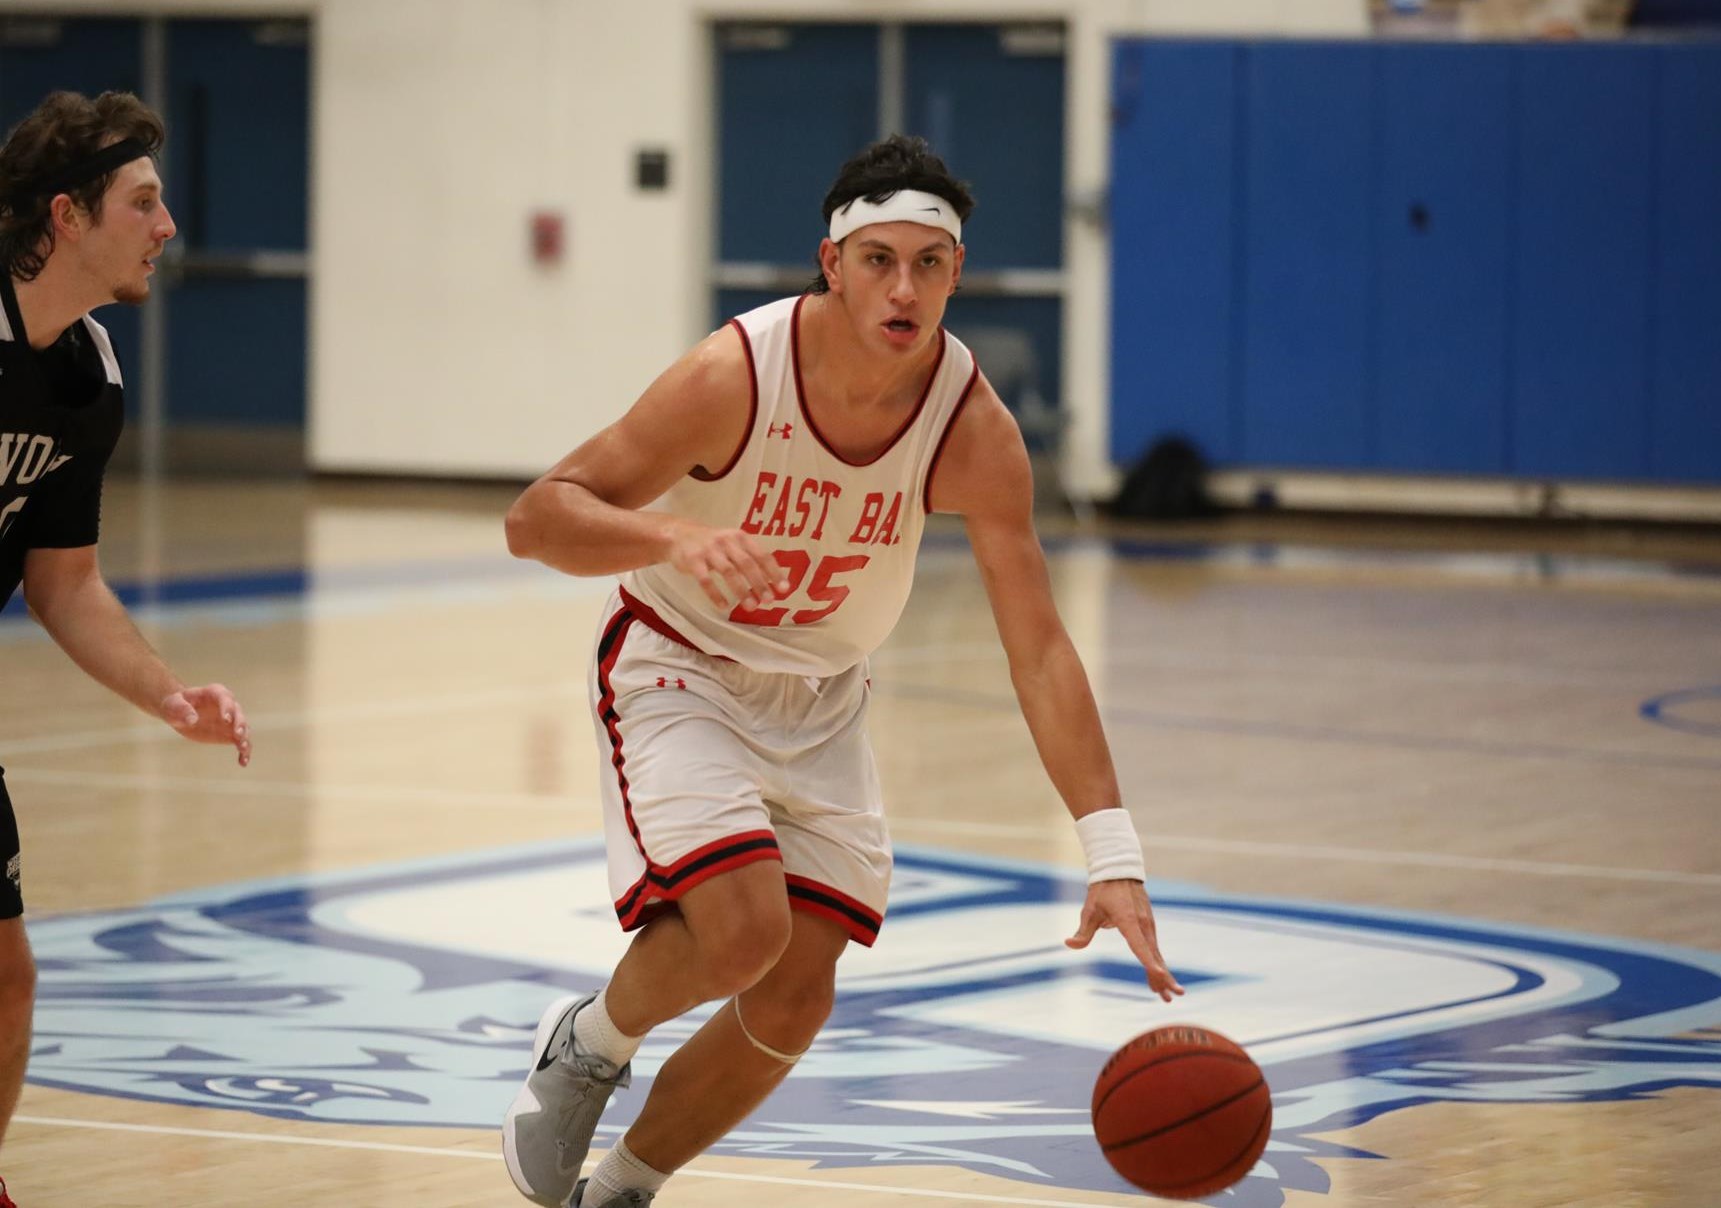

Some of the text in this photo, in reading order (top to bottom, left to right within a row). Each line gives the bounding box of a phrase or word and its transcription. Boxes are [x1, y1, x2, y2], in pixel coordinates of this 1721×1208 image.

[740, 471, 903, 546] EAST BA
[728, 549, 871, 628] 25
